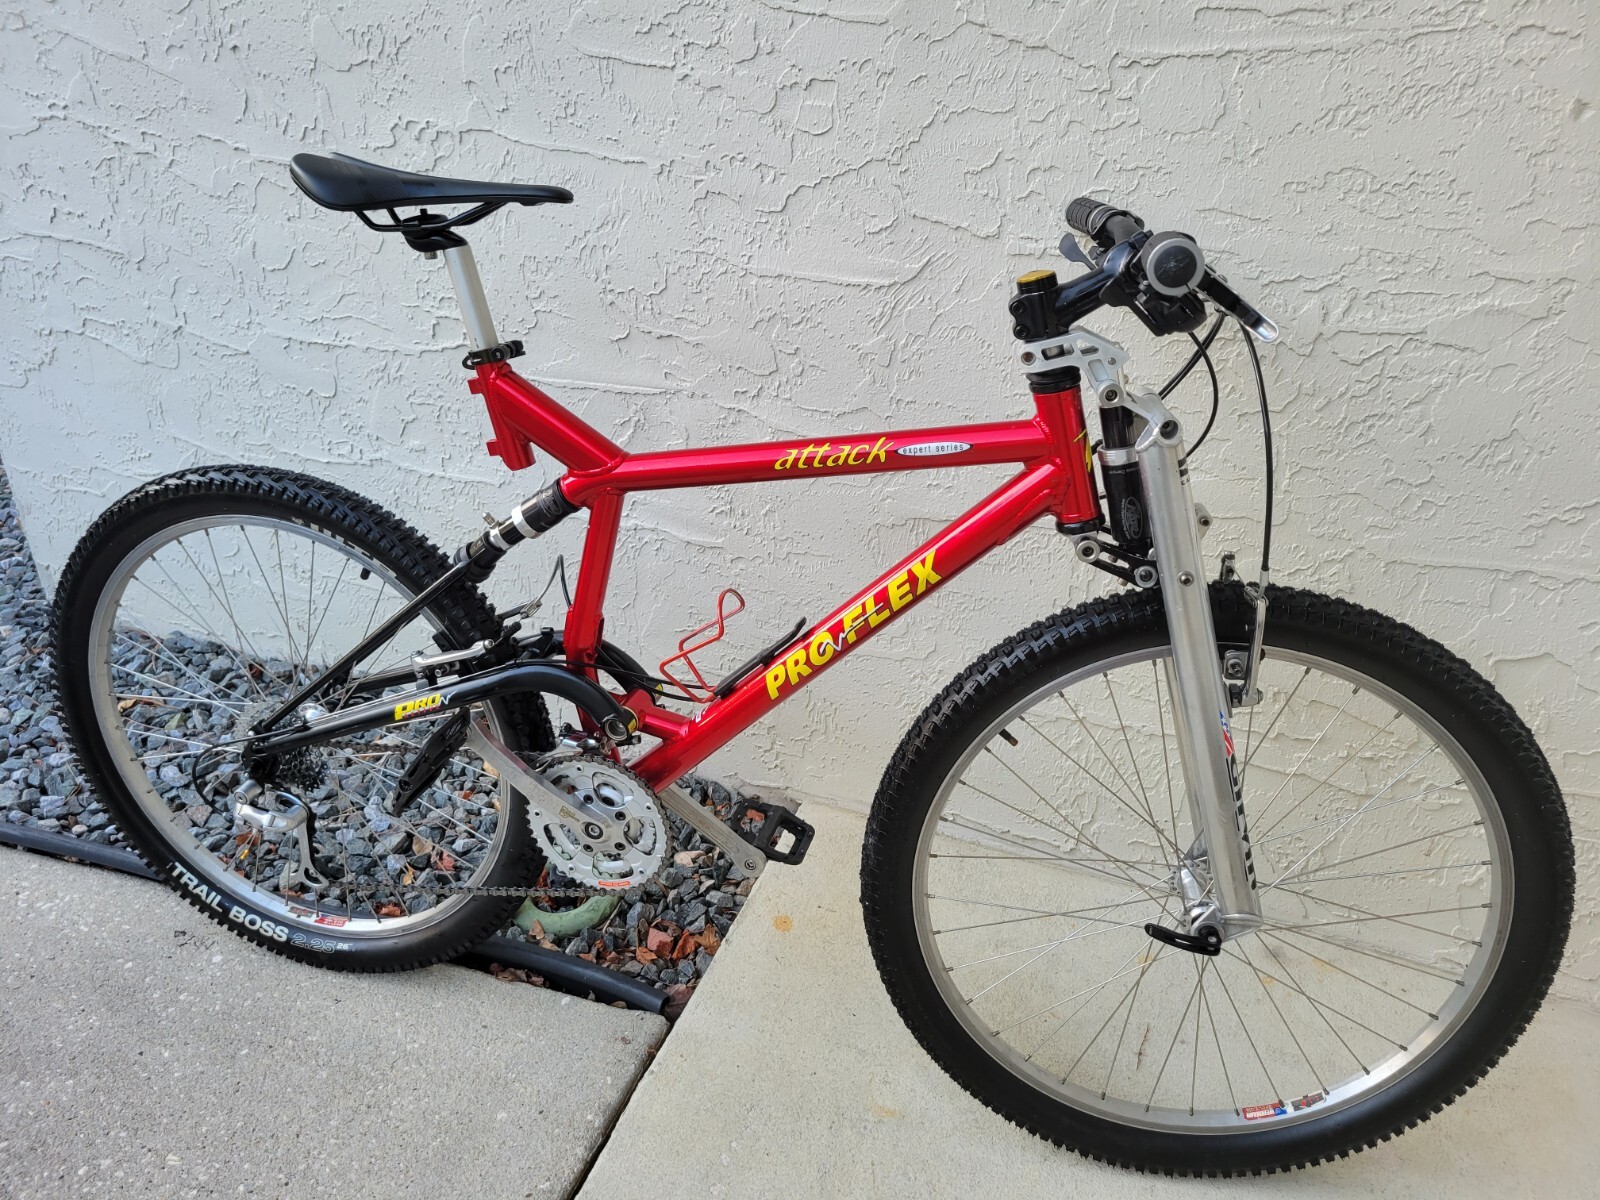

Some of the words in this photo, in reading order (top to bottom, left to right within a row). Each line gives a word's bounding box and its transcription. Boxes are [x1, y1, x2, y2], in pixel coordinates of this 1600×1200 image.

[774, 436, 895, 471] attack
[902, 443, 932, 456] expert
[935, 443, 965, 454] series
[171, 861, 223, 913] TRAIL
[228, 904, 289, 943] BOSS
[291, 932, 337, 954] 2.25
